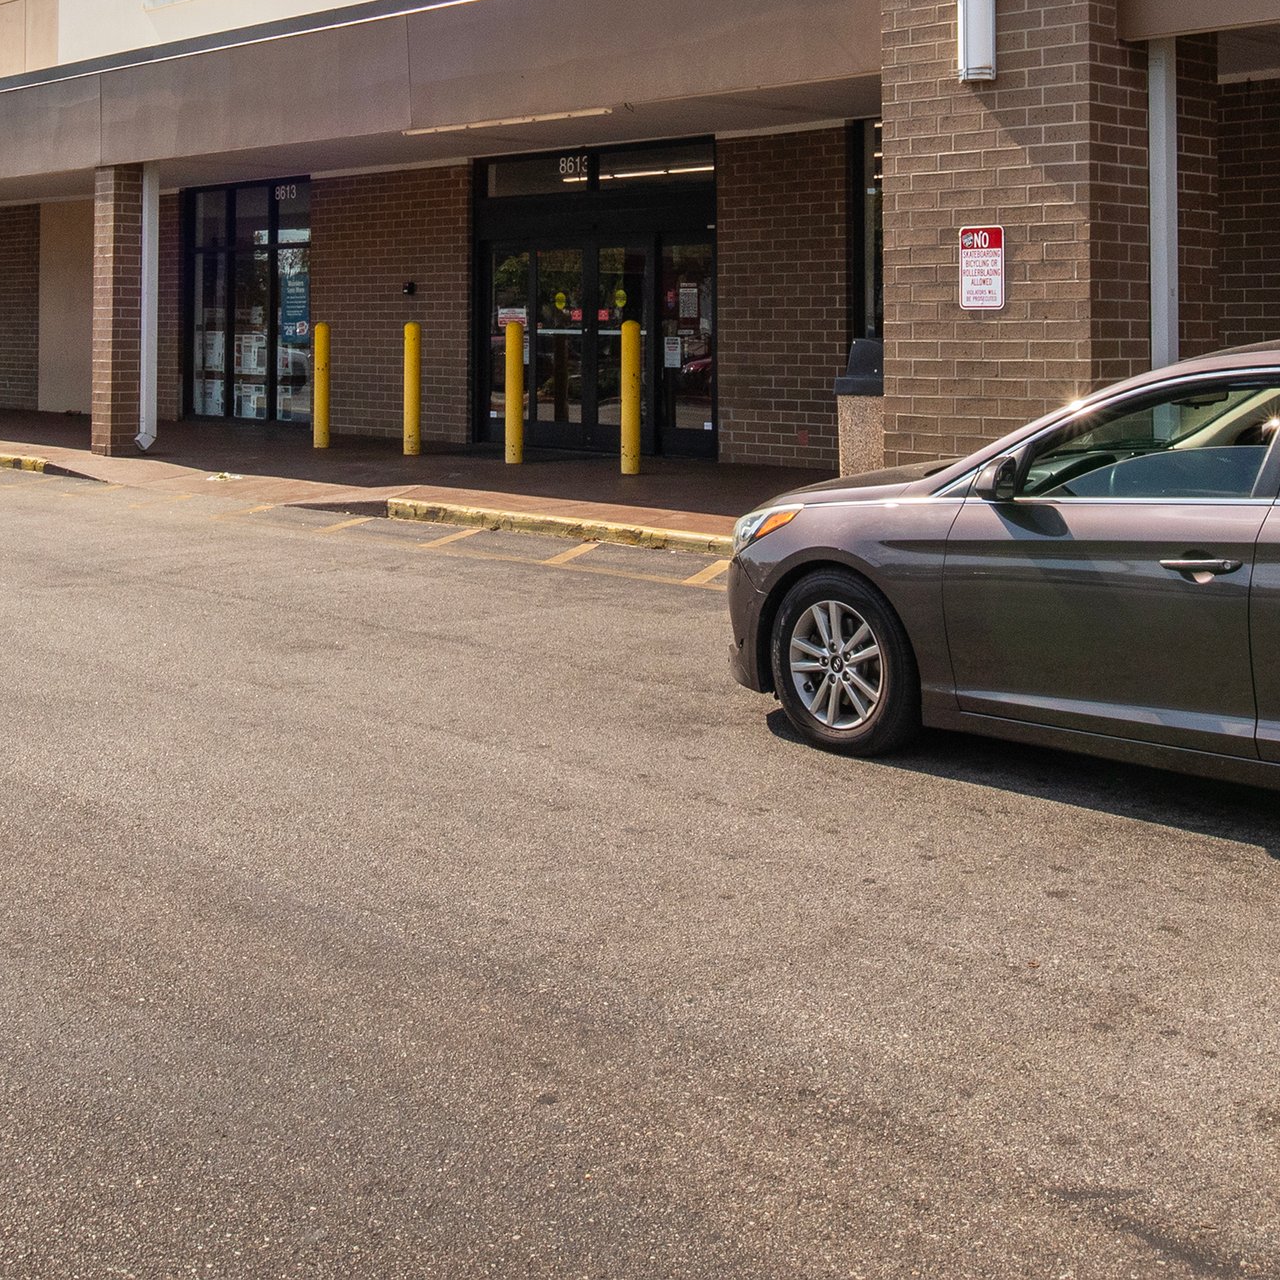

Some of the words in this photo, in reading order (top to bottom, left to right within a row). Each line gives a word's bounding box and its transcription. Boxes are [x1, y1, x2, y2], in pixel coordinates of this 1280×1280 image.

[559, 155, 588, 173] 8613
[275, 185, 297, 200] 8613
[974, 231, 989, 248] NO
[963, 250, 1000, 258] SKATEBOARDING
[966, 260, 989, 268] BICYCLING
[991, 259, 998, 267] OR
[963, 269, 1000, 277] ROLLERBLADING
[971, 278, 992, 286] ALLOWED
